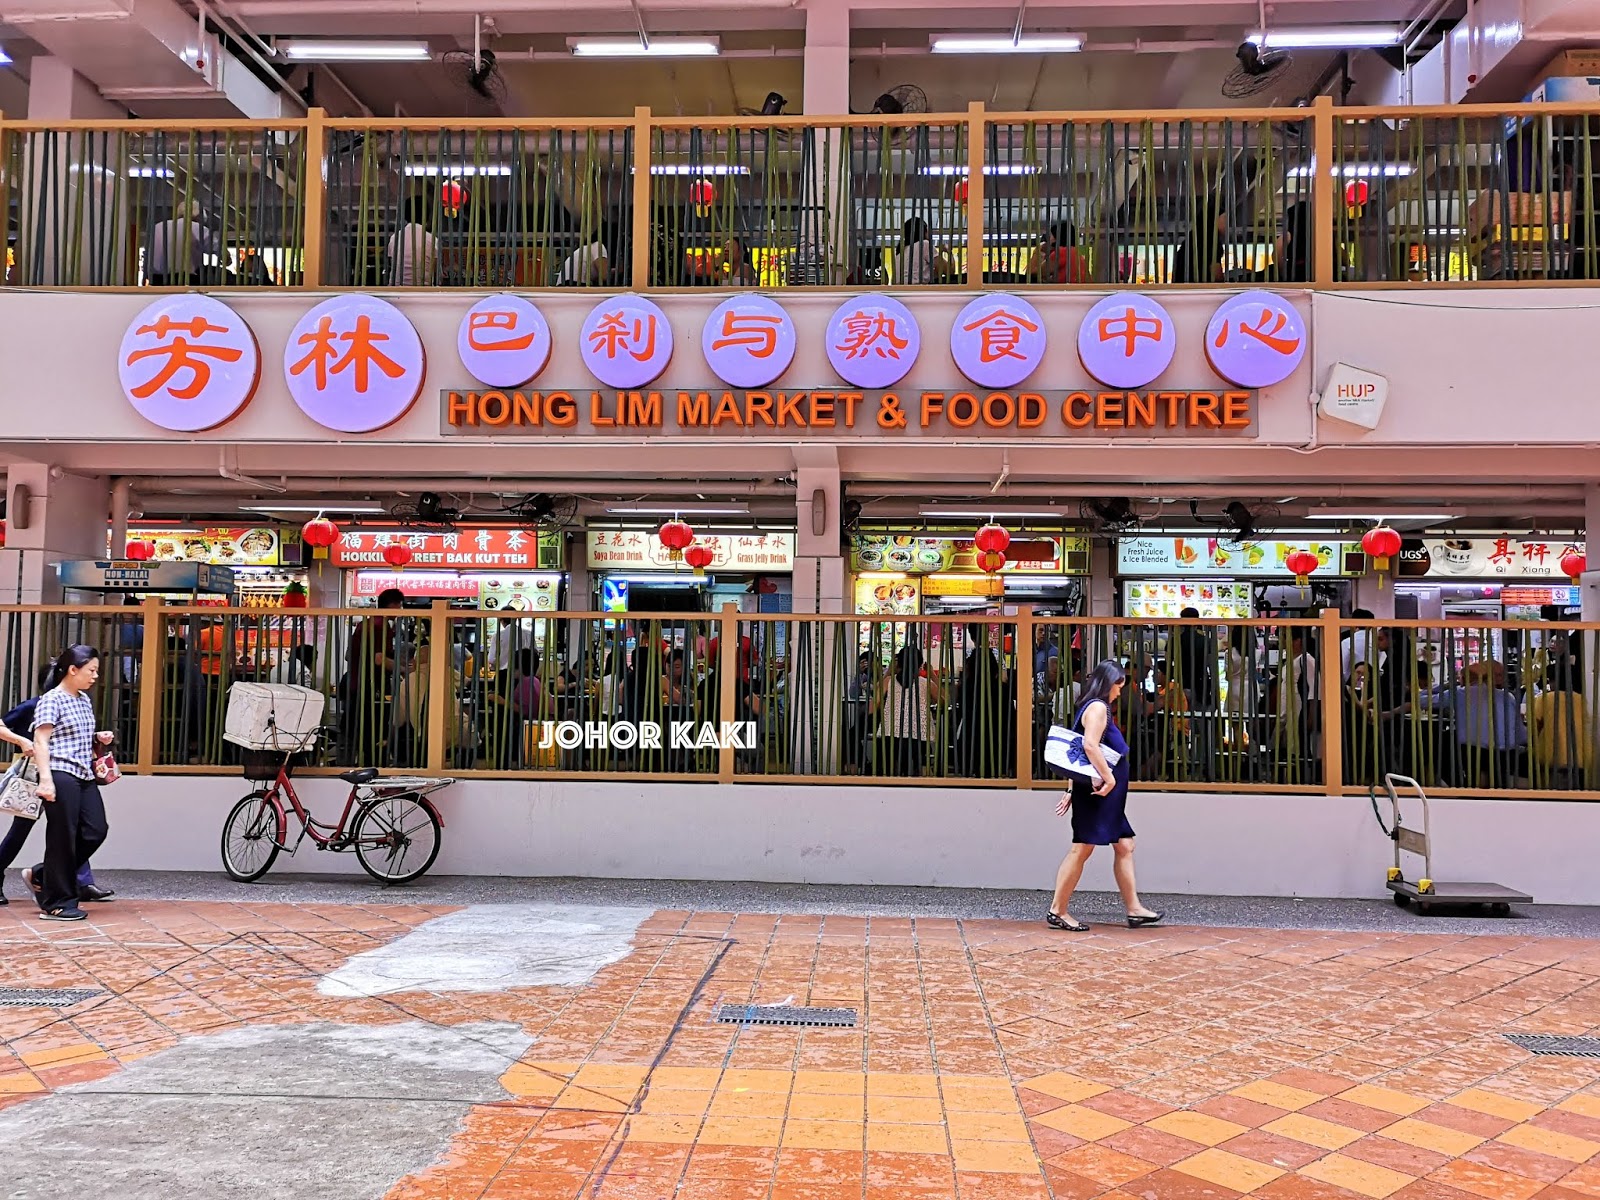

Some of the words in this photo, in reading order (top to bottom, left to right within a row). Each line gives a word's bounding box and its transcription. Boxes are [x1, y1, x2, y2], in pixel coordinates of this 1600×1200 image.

[126, 309, 1301, 399] 芳林巴刹与熟食中心
[1337, 384, 1375, 398] HUP
[447, 391, 578, 427] HONG
[590, 391, 663, 427] LIM
[677, 391, 864, 427] MARKET
[876, 391, 907, 428] &
[920, 391, 1048, 428] FOOD
[1062, 391, 1251, 428] CENTRE
[595, 532, 642, 547] 豆花水
[593, 551, 608, 562] Soya
[609, 551, 625, 561] Bean
[626, 551, 643, 561] Drink
[1127, 548, 1145, 556] Fresh
[1146, 548, 1164, 556] Juice
[446, 553, 474, 563] BAK
[475, 553, 501, 563] KUT
[503, 553, 528, 564] TEH
[737, 553, 754, 564] Grass
[754, 553, 769, 564] Jelly
[769, 553, 787, 564] Drink
[1521, 566, 1551, 575] Xiang
